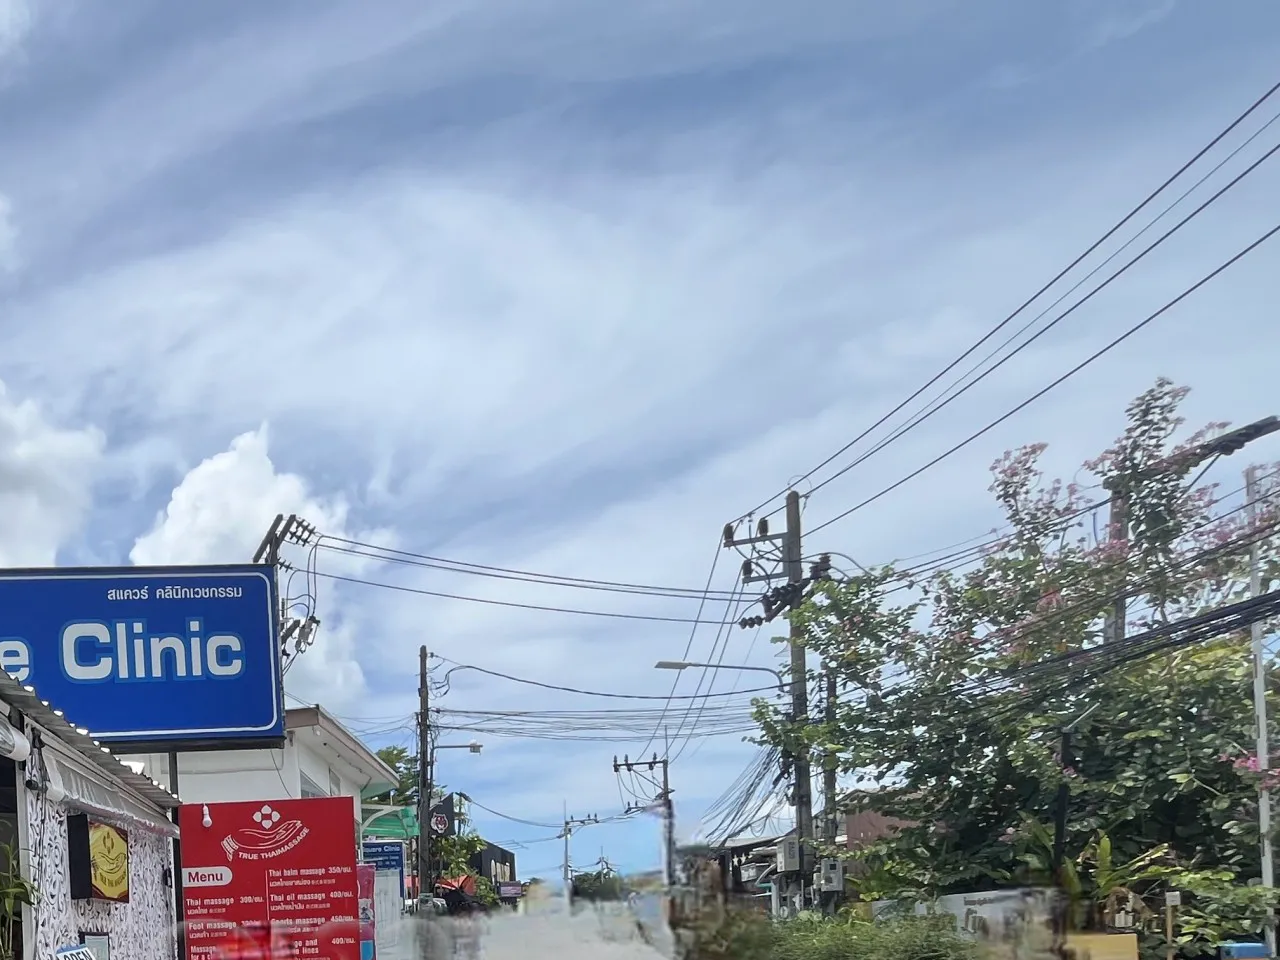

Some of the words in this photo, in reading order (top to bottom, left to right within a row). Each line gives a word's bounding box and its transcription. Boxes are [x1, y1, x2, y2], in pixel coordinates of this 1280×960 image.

[108, 586, 148, 600] สแควร์
[156, 586, 242, 599] คลินิกเวชกรรม
[62, 620, 243, 680] Clinic
[284, 868, 298, 876] balm
[188, 872, 223, 882] Menu
[298, 893, 325, 901] massage
[186, 898, 201, 906] Thai
[296, 917, 325, 925] massage
[189, 922, 203, 930] Foot
